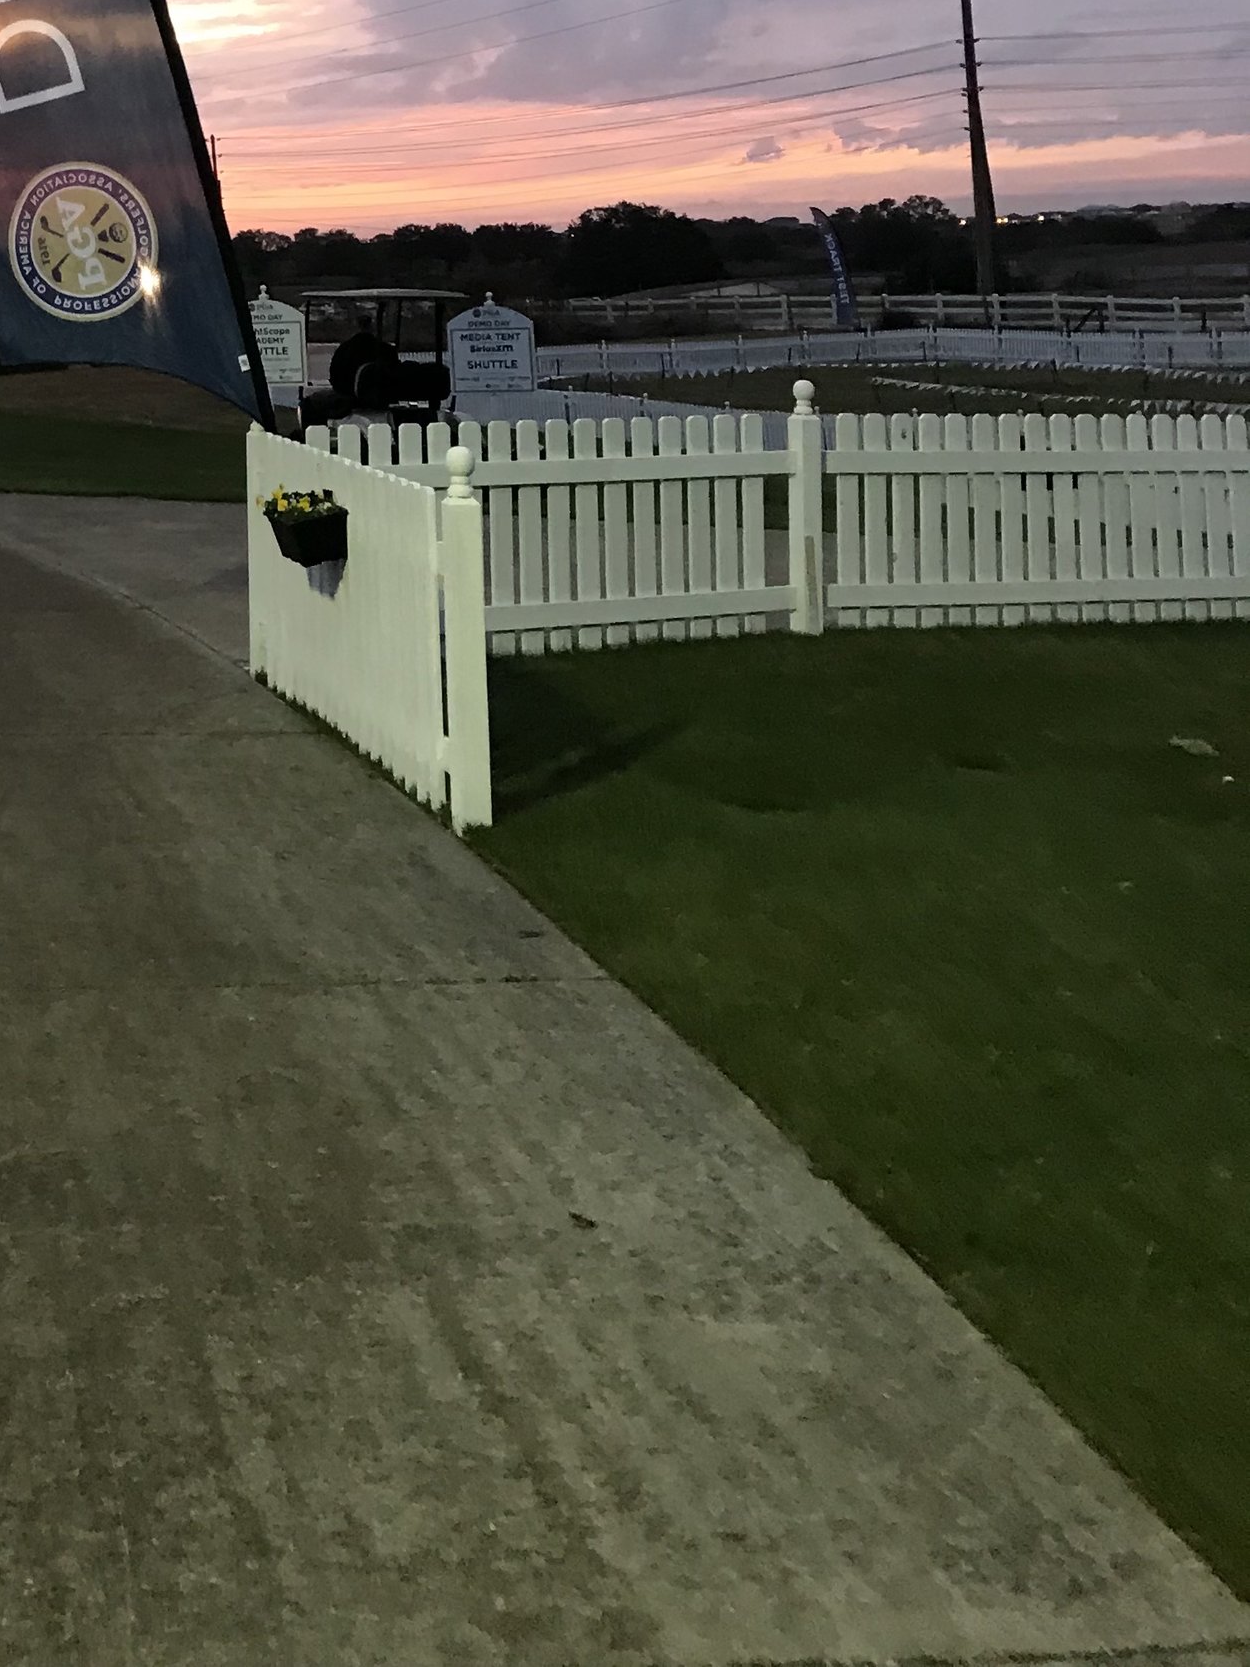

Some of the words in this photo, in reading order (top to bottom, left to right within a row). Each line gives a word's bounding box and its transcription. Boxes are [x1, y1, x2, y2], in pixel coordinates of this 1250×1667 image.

[460, 333, 492, 341] MEDIA
[495, 332, 521, 341] TENT
[467, 359, 519, 369] SHUTTLE
